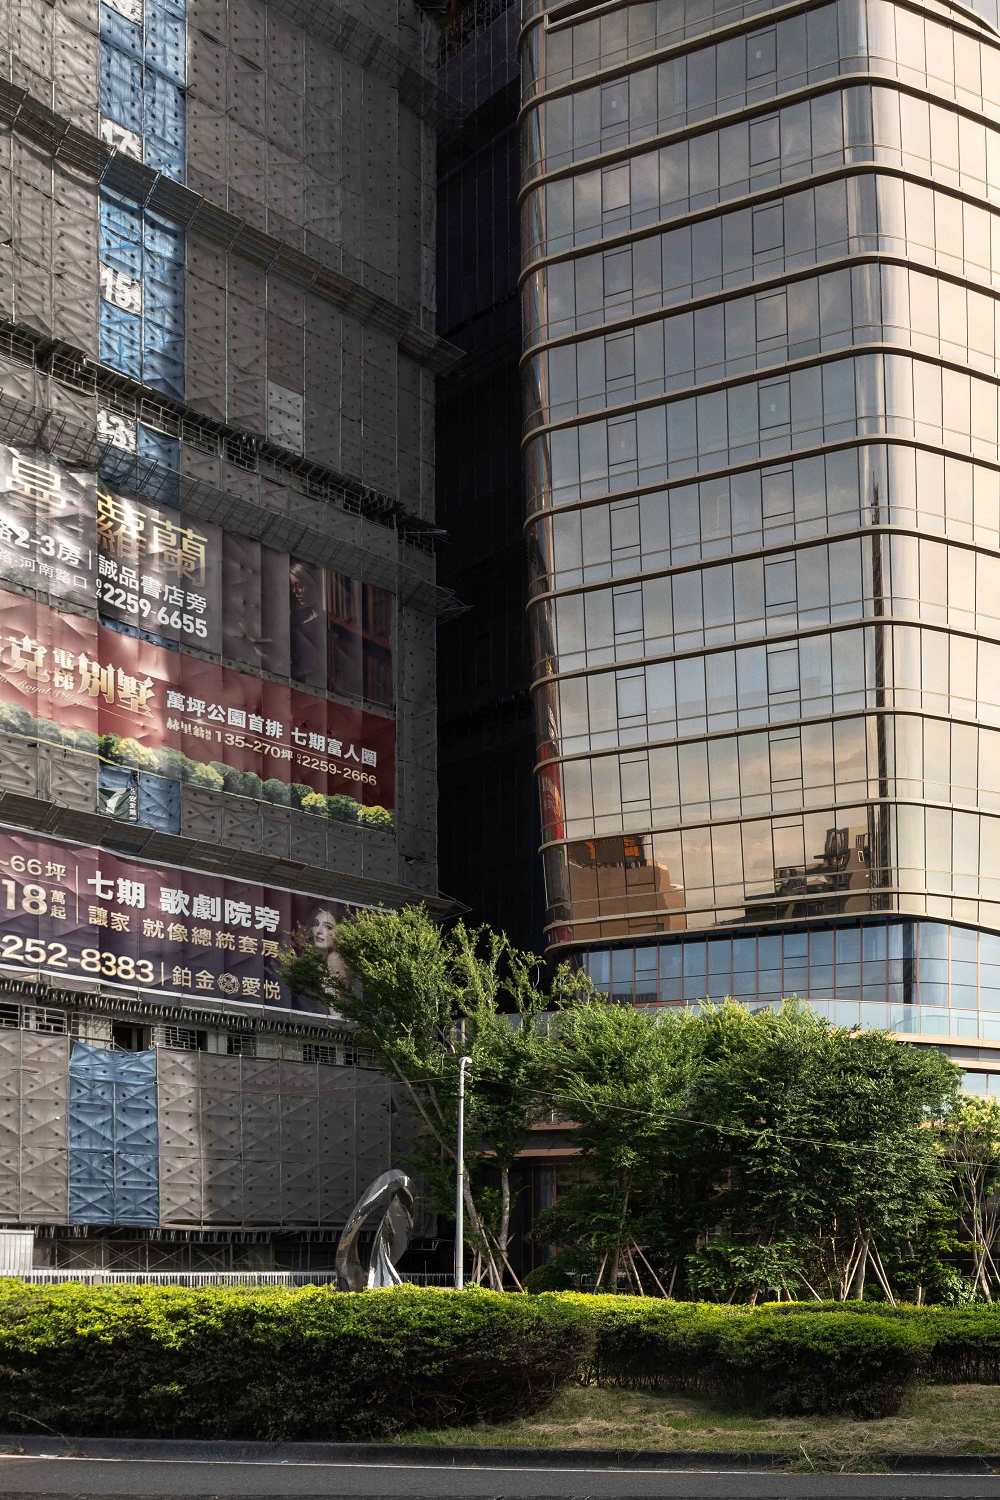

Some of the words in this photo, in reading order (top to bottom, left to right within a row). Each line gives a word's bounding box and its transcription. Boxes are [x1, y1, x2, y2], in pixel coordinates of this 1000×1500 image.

[101, 266, 132, 308] 15
[98, 554, 207, 615] 誠品書店旁
[103, 583, 208, 638] 2259-6655
[166, 690, 283, 739] 萬坪公園首排
[290, 727, 377, 768] 七期富人圈
[302, 756, 377, 786] 2259-2666
[87, 871, 146, 909] 七期
[159, 886, 280, 933] 歌劇院旁
[1, 934, 155, 983] 252-8383
[88, 905, 130, 932] 讓家
[142, 918, 280, 959] 就像總統套房
